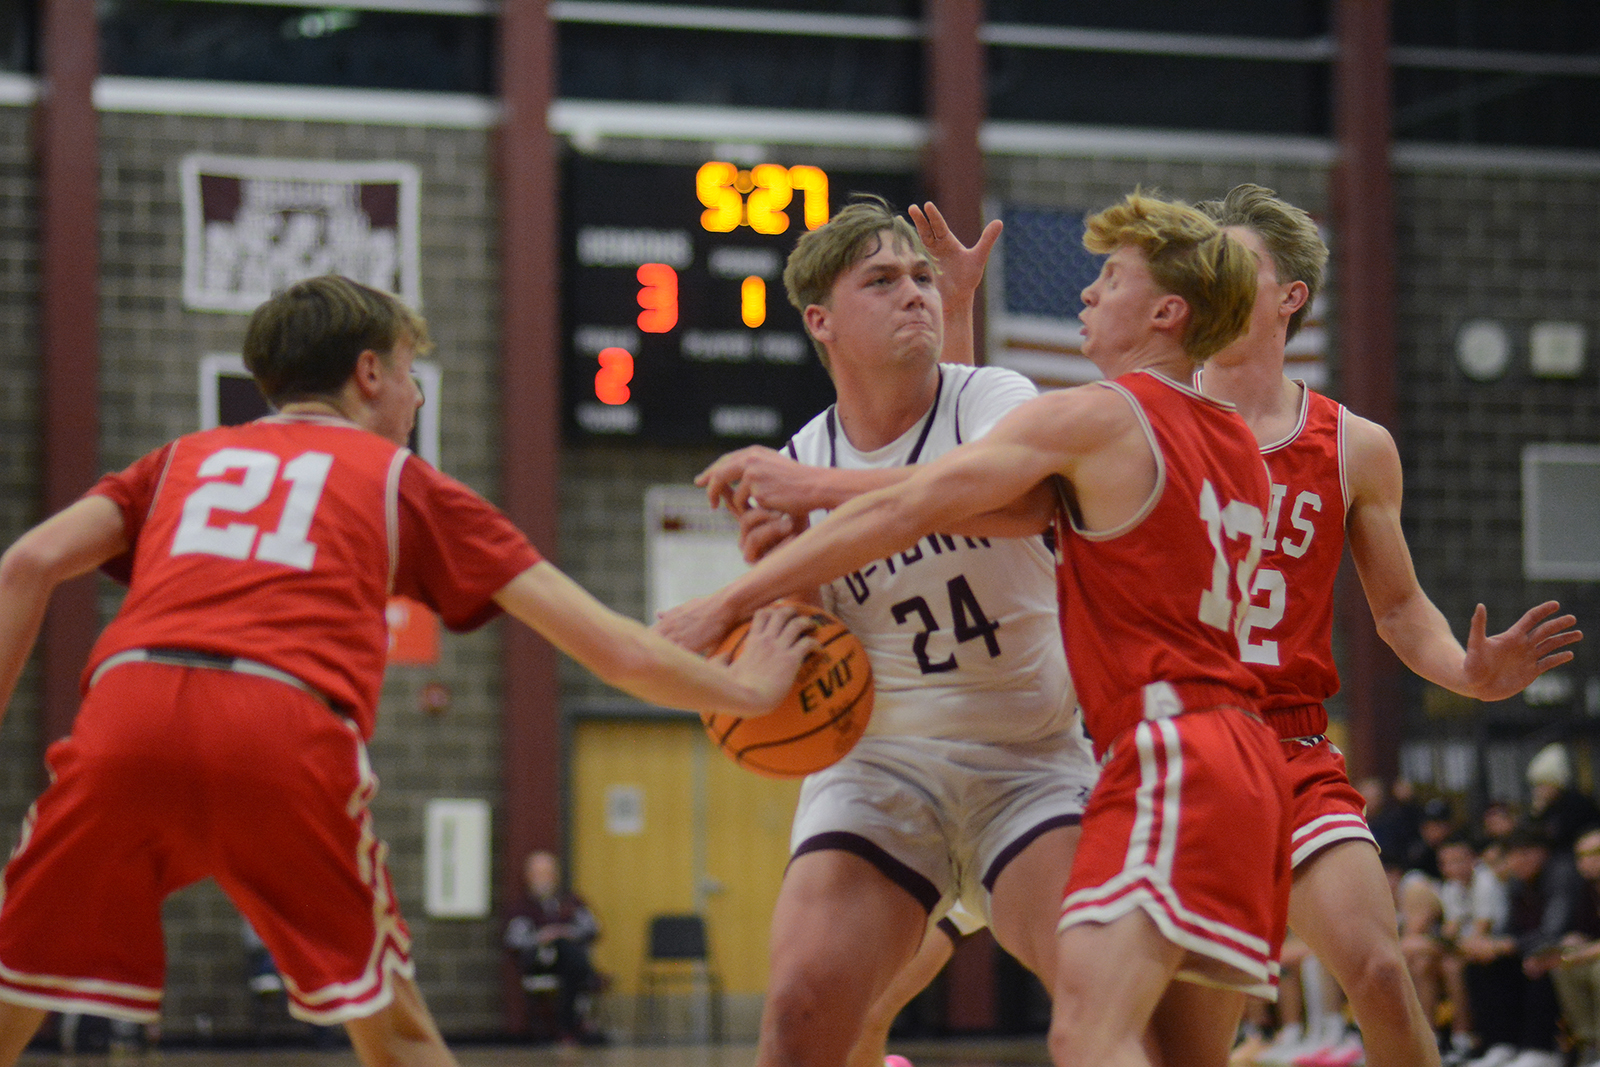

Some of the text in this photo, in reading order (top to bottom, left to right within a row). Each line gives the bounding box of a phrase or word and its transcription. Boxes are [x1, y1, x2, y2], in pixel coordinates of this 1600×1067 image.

[636, 263, 679, 333] 3
[741, 275, 766, 328] 1
[594, 347, 634, 405] 2
[170, 448, 334, 571] 21
[891, 574, 1001, 675] 24
